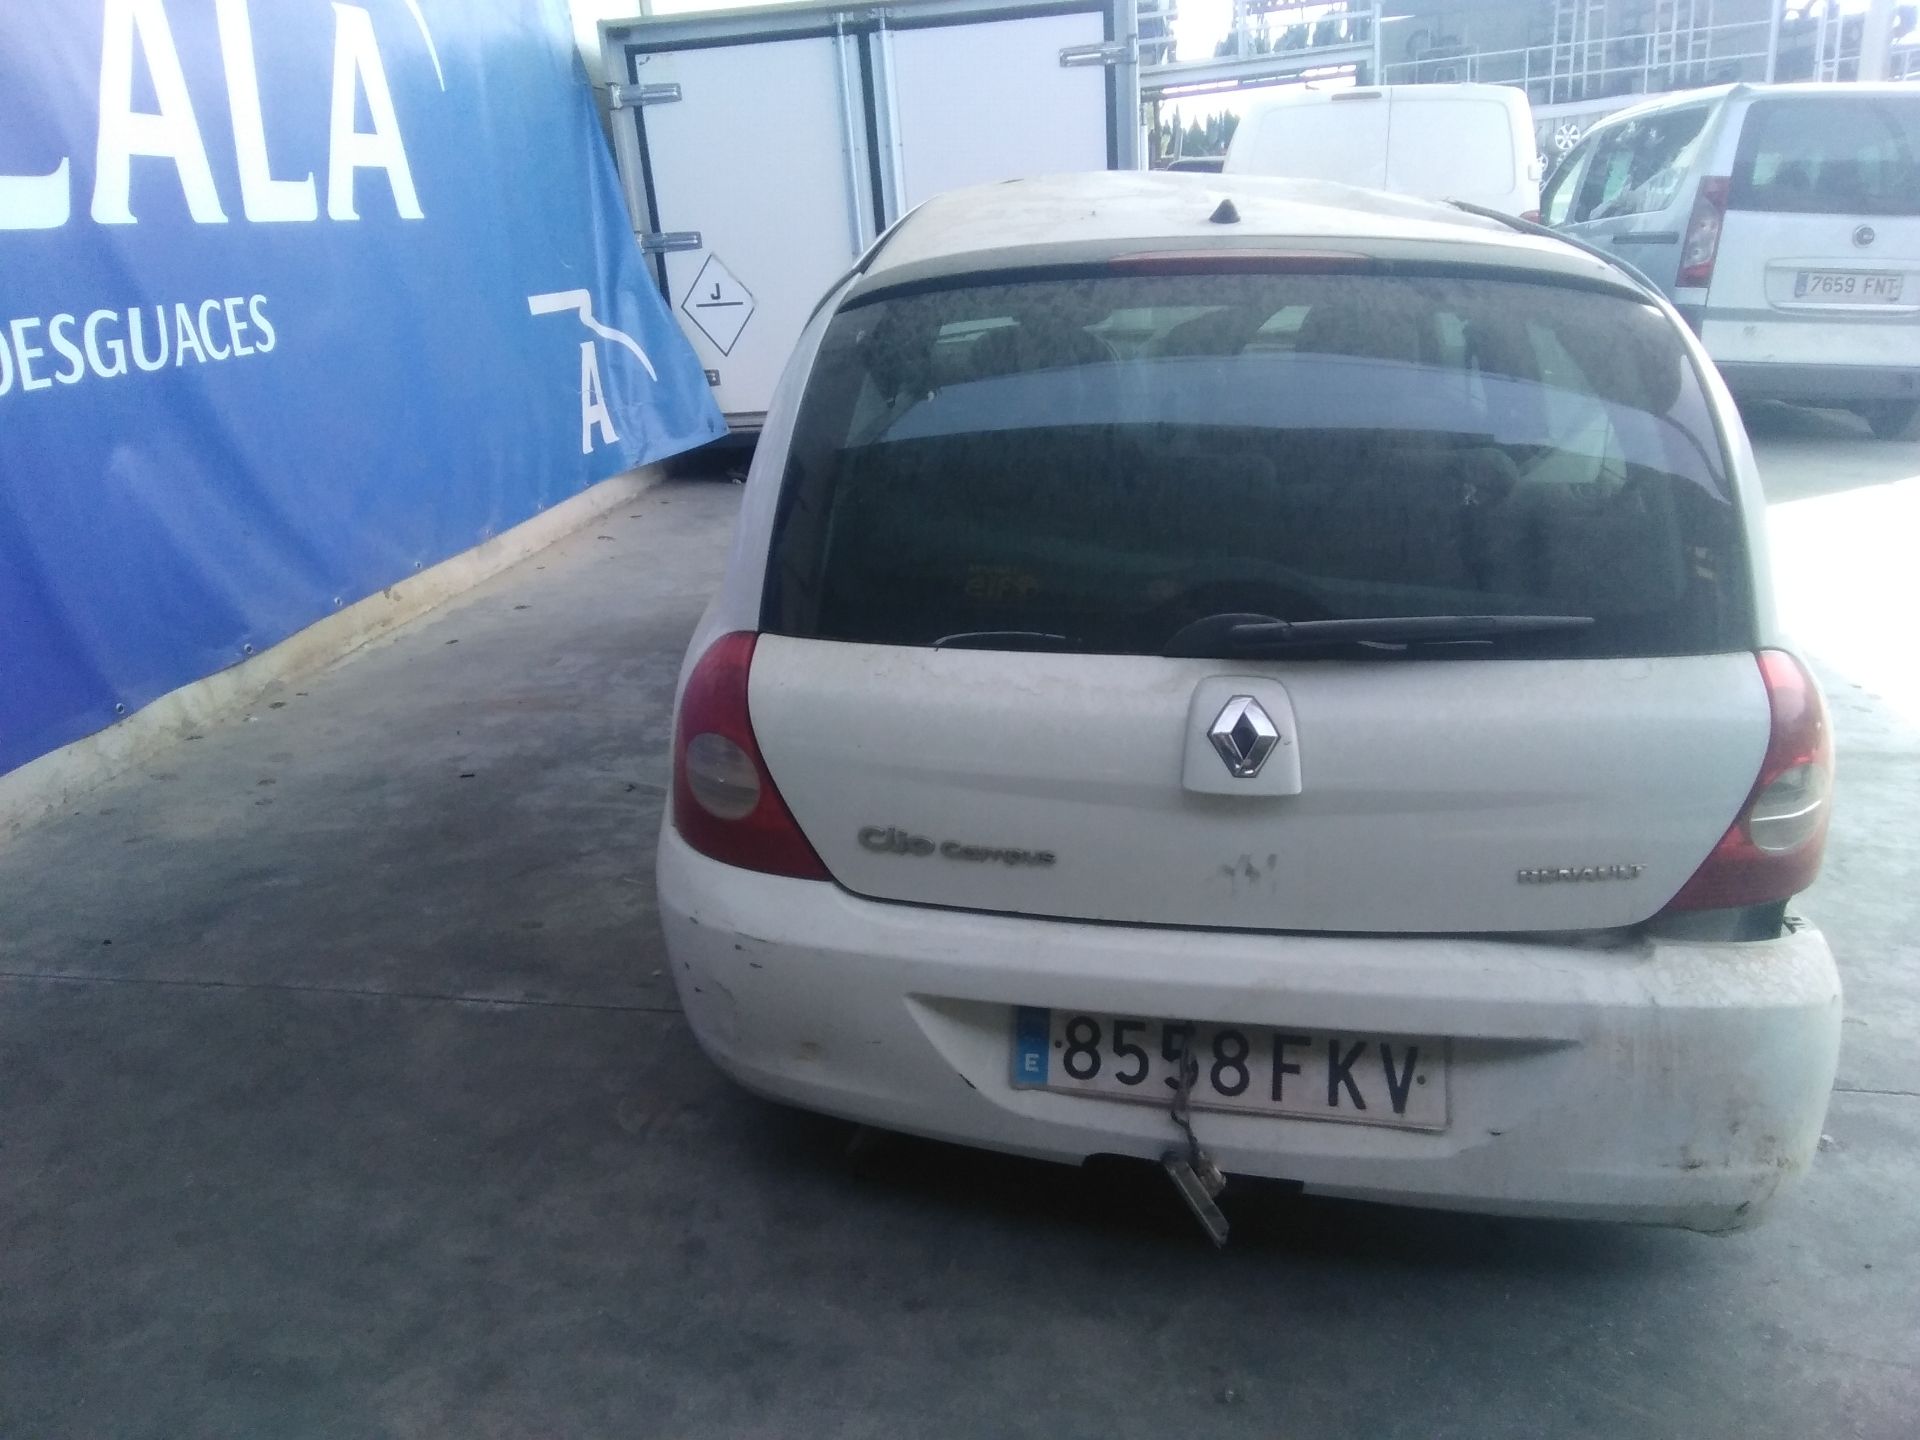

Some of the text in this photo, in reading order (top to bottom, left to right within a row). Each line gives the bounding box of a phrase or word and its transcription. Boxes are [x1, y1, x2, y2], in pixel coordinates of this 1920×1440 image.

[0, 0, 425, 229] ALA
[710, 283, 721, 300] J
[1810, 276, 1897, 294] 7659 FNT
[858, 825, 935, 857] Clio
[1517, 863, 1648, 884] RENAULT
[1025, 1016, 1418, 1114] E 8558 FKV
